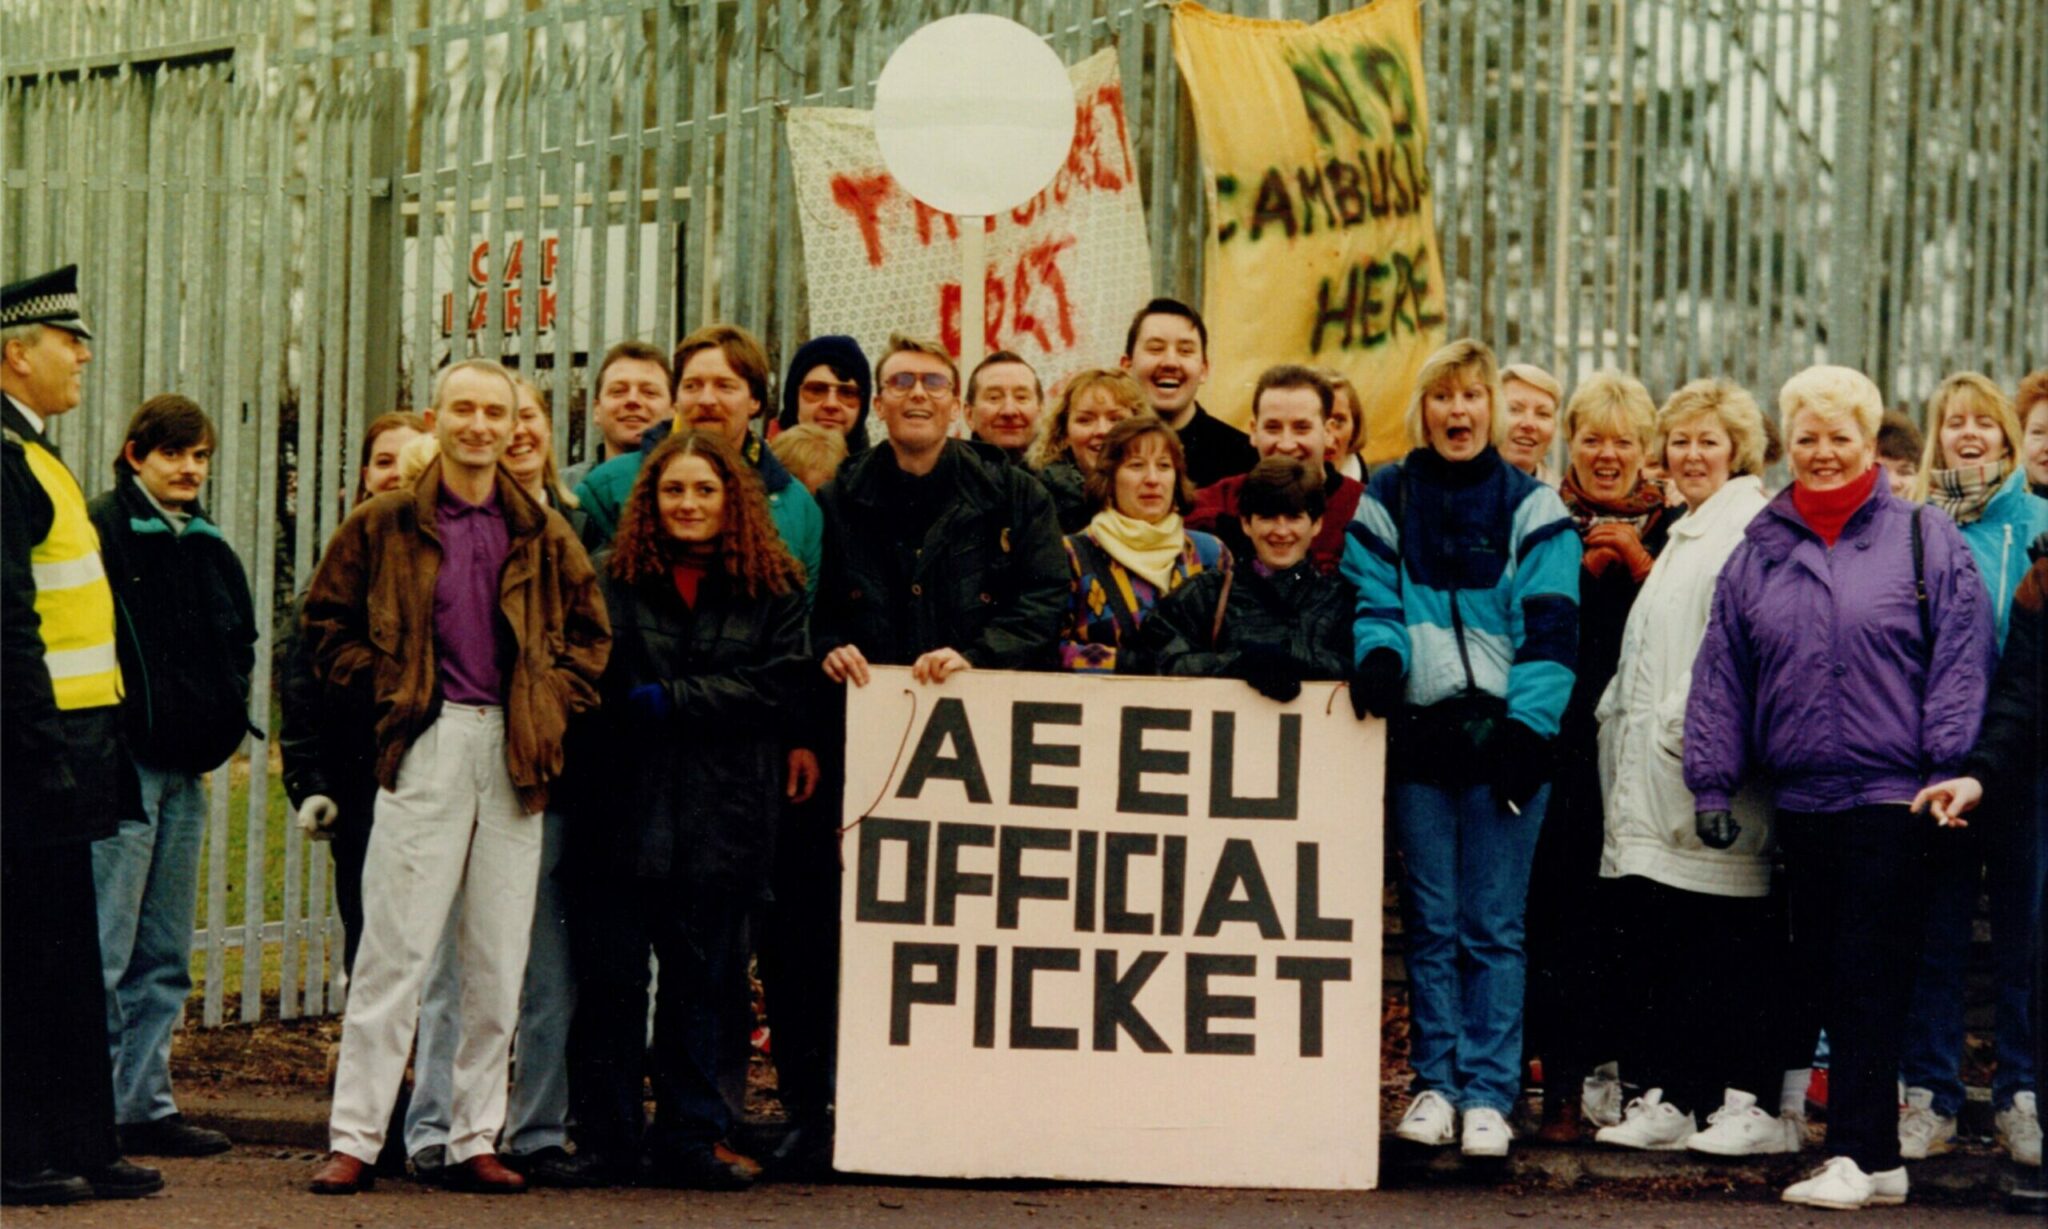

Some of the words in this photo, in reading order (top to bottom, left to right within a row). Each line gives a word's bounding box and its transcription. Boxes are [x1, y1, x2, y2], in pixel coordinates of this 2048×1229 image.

[1291, 42, 1416, 145] NO
[1310, 246, 1444, 356] HERE
[895, 697, 1302, 820] AEEU
[856, 816, 1353, 942] OFFICIAL
[889, 941, 1352, 1058] PICKET
